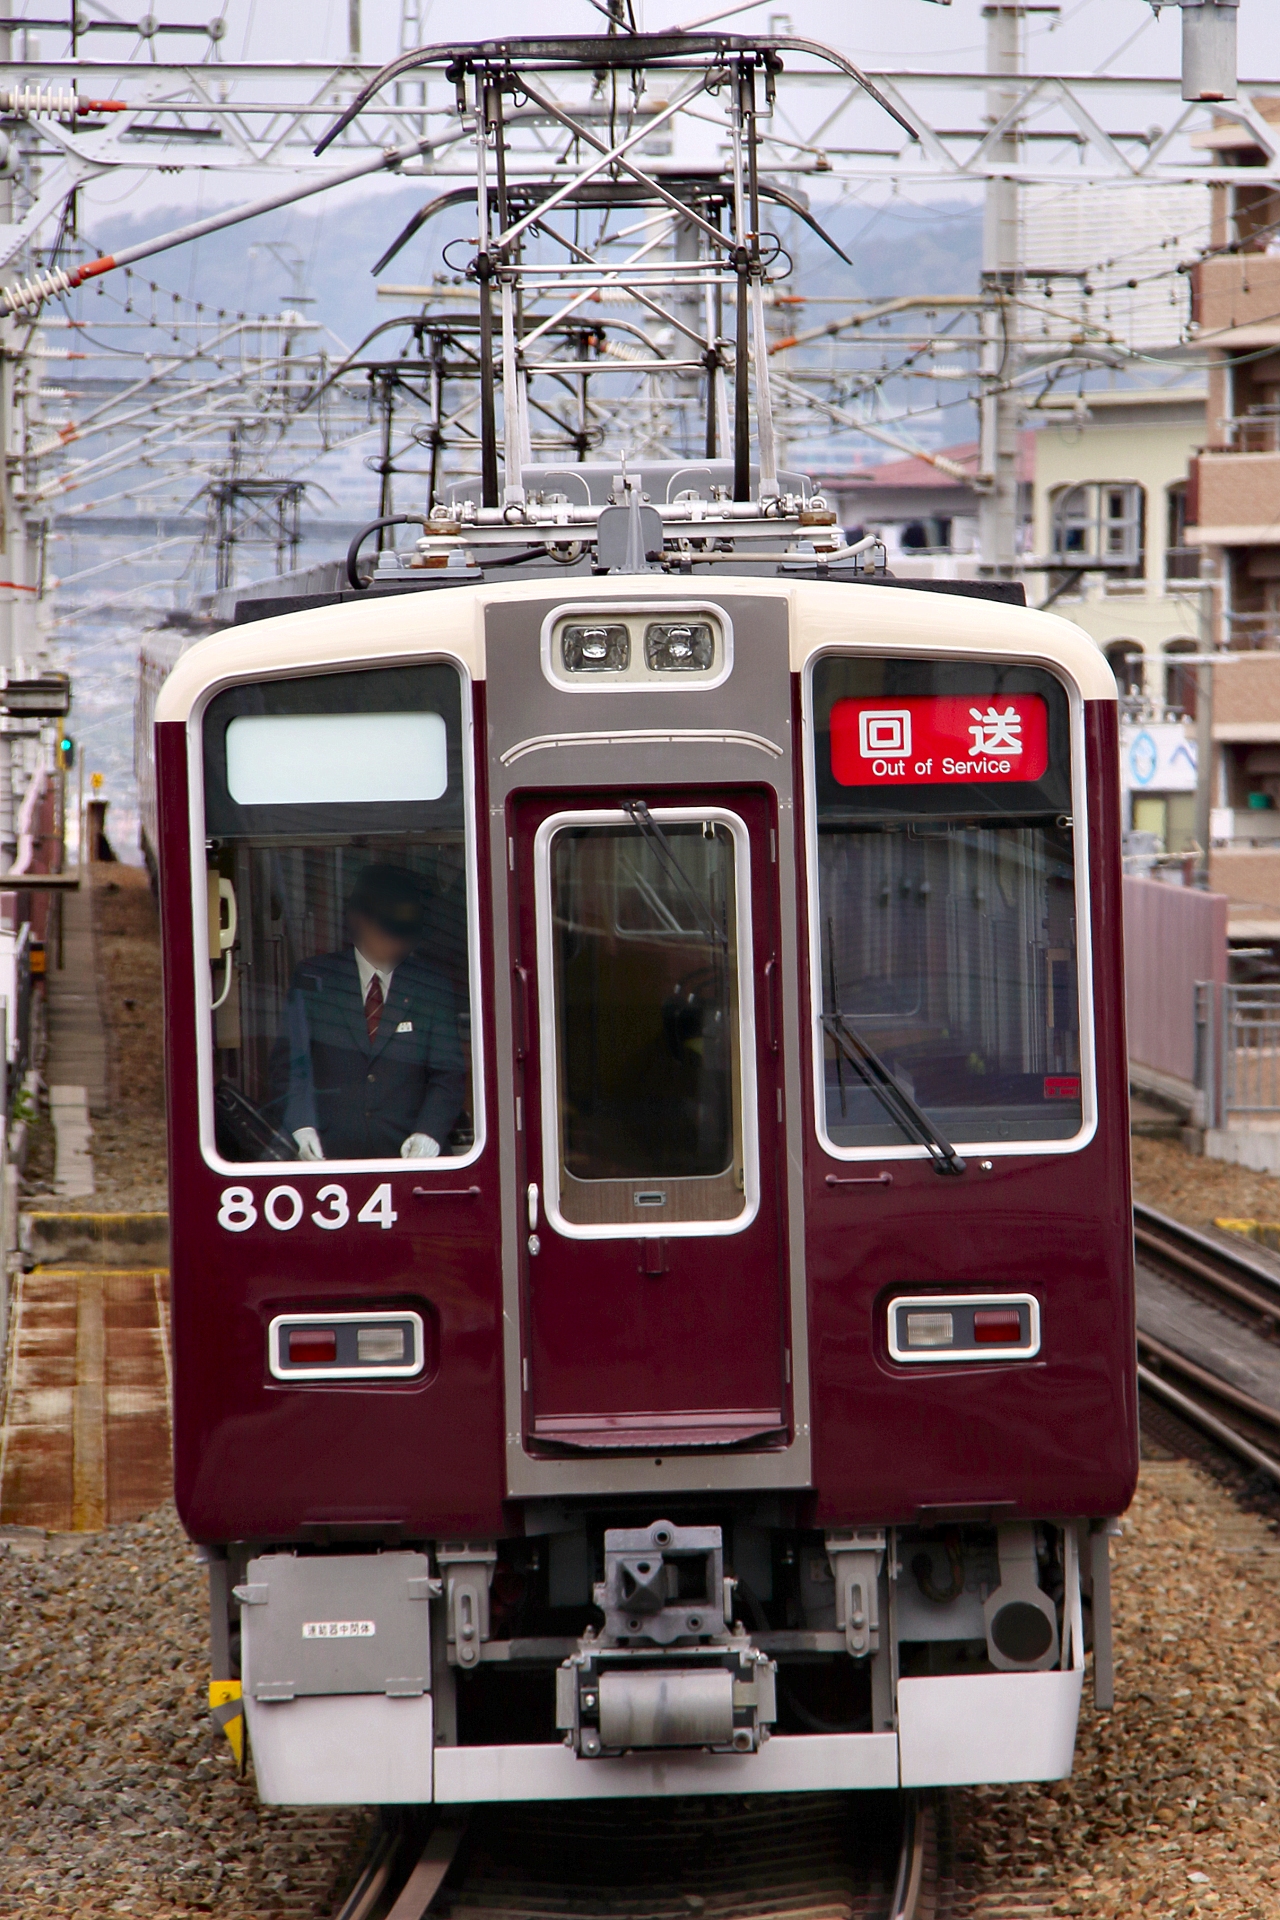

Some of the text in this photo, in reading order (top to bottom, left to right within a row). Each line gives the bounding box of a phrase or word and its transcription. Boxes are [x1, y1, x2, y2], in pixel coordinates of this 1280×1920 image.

[858, 706, 1023, 758] 回送
[872, 757, 1011, 776] Out of Service
[217, 1183, 398, 1232] 8034
